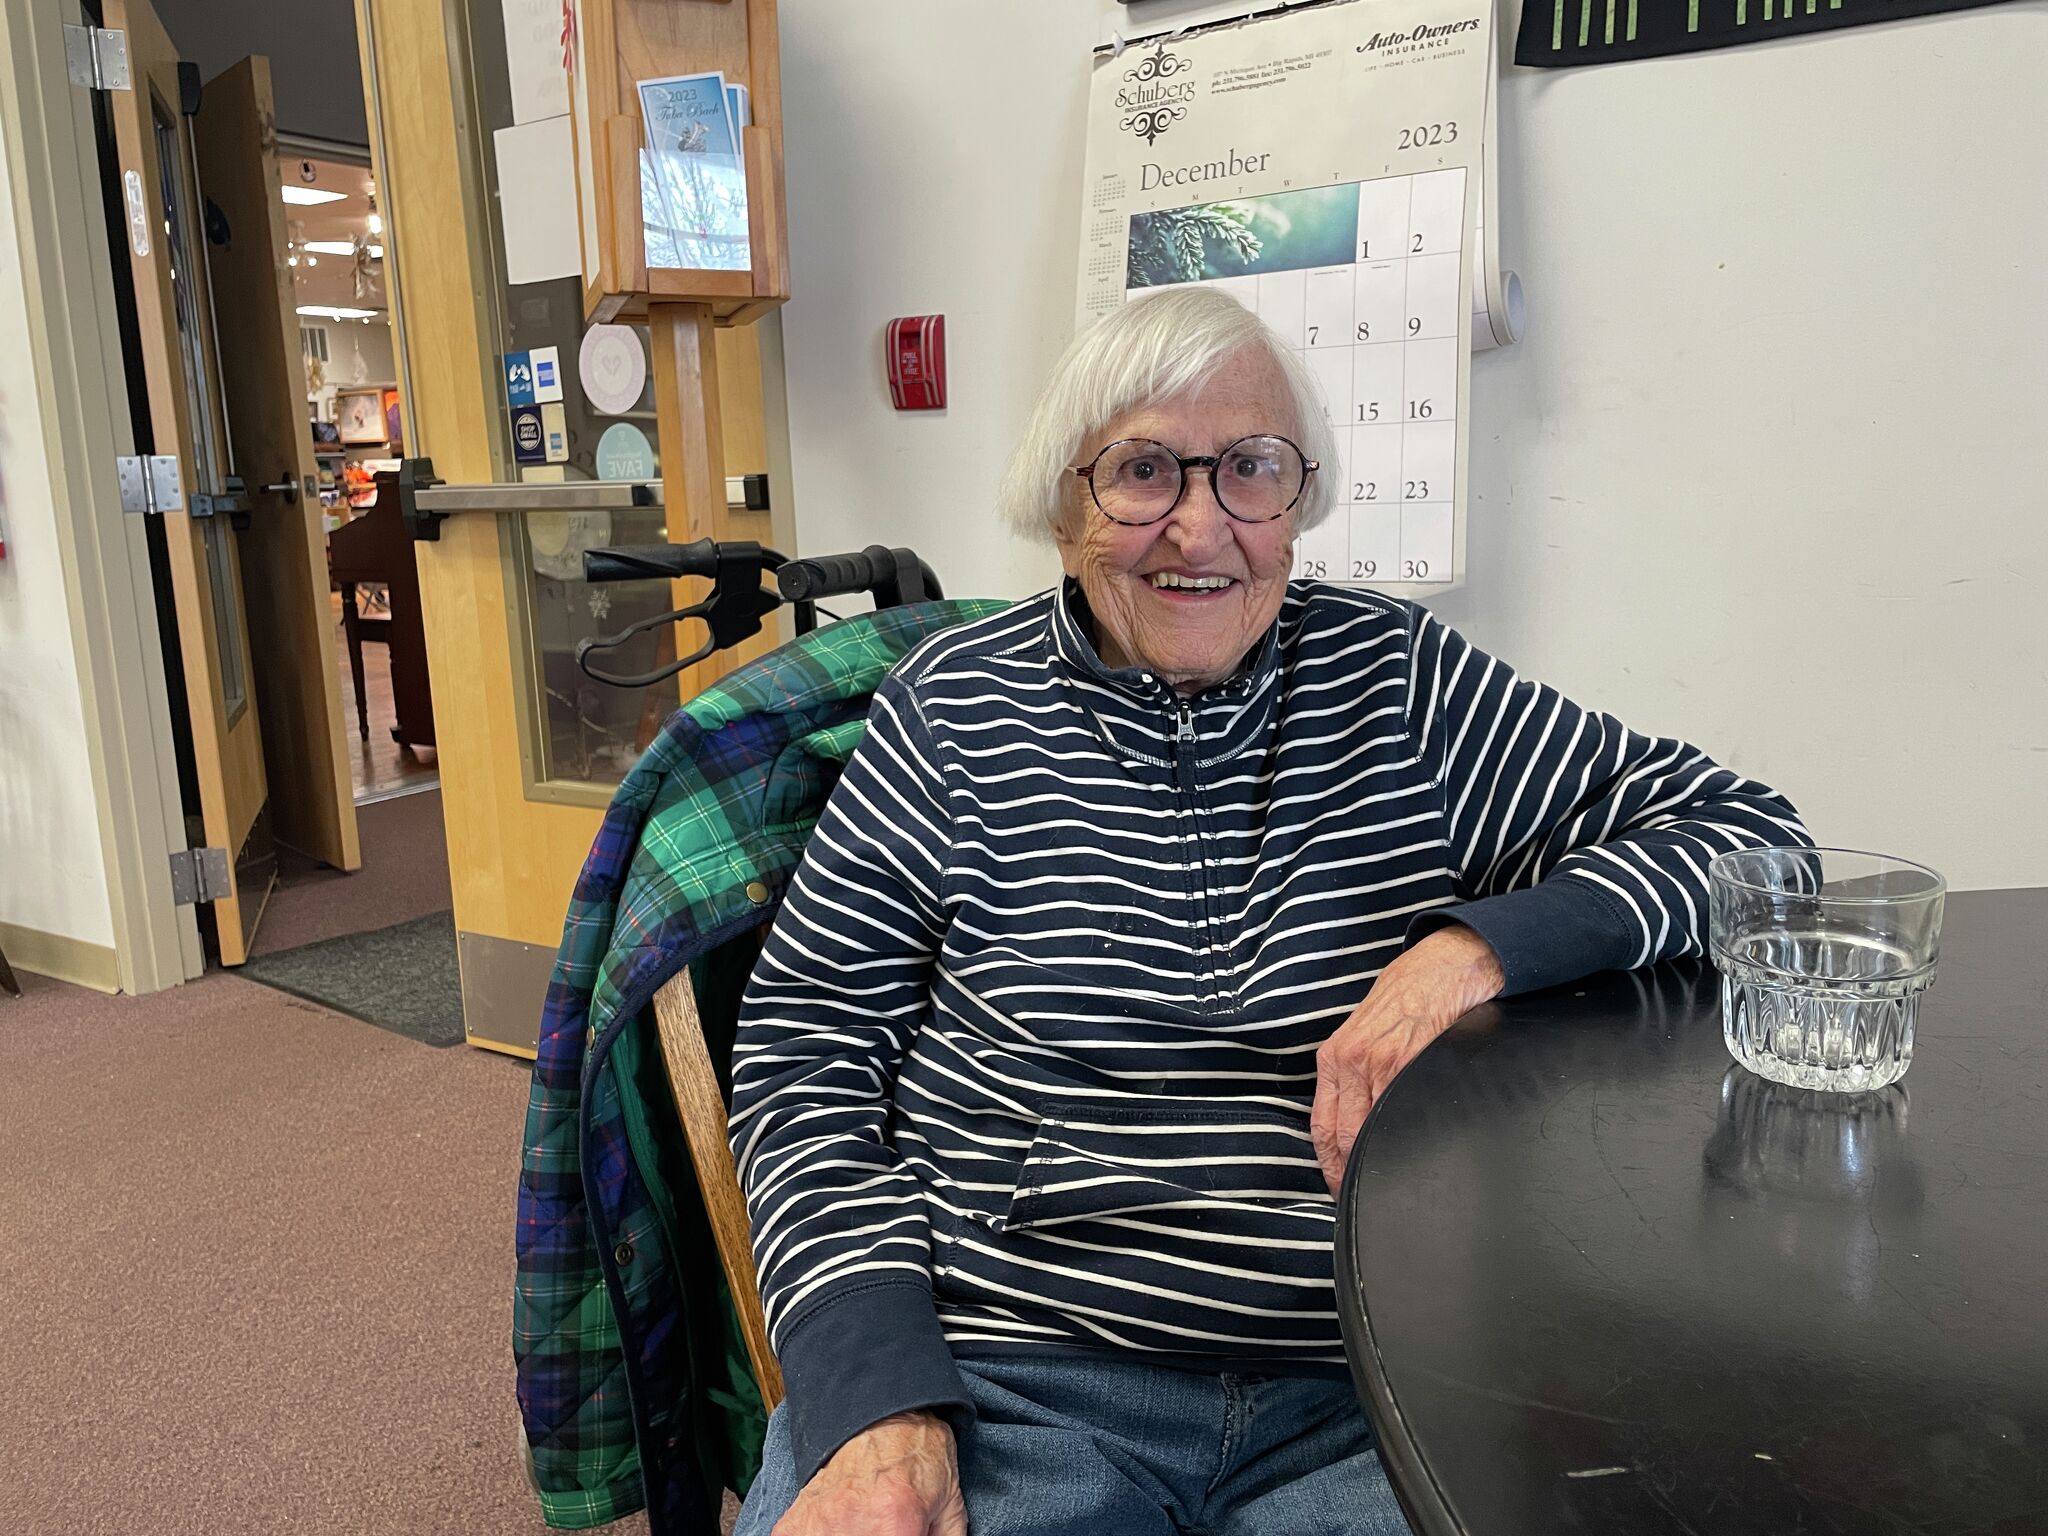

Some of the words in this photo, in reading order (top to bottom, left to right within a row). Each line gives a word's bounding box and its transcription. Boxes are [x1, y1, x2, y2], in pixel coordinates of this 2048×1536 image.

[1356, 18, 1480, 53] Auto-Owners
[1381, 38, 1449, 57] INSURANCE
[1364, 65, 1377, 73] LIFE
[1384, 60, 1404, 68] HOME
[1411, 56, 1425, 64] CAR
[1433, 48, 1466, 60] BUSINESS
[668, 89, 698, 102] 2023
[1115, 80, 1195, 107] Schuberg
[1125, 102, 1158, 113] INSURANCE
[1159, 97, 1183, 106] AGENCY
[655, 105, 683, 120] Tuba
[686, 102, 719, 118] Bach
[1397, 121, 1458, 150] 2023
[1140, 148, 1271, 191] December
[1362, 240, 1370, 258] 1
[1412, 234, 1423, 253] 2
[1308, 326, 1319, 345] 7
[1357, 321, 1369, 341] 8
[1408, 317, 1421, 337] 9
[1357, 402, 1379, 421] 15
[1409, 398, 1432, 419] 16
[1354, 482, 1377, 500] 22
[1405, 480, 1429, 499] 23
[1303, 560, 1327, 578] 28
[1352, 560, 1376, 578] 29
[1403, 560, 1429, 578] 30
